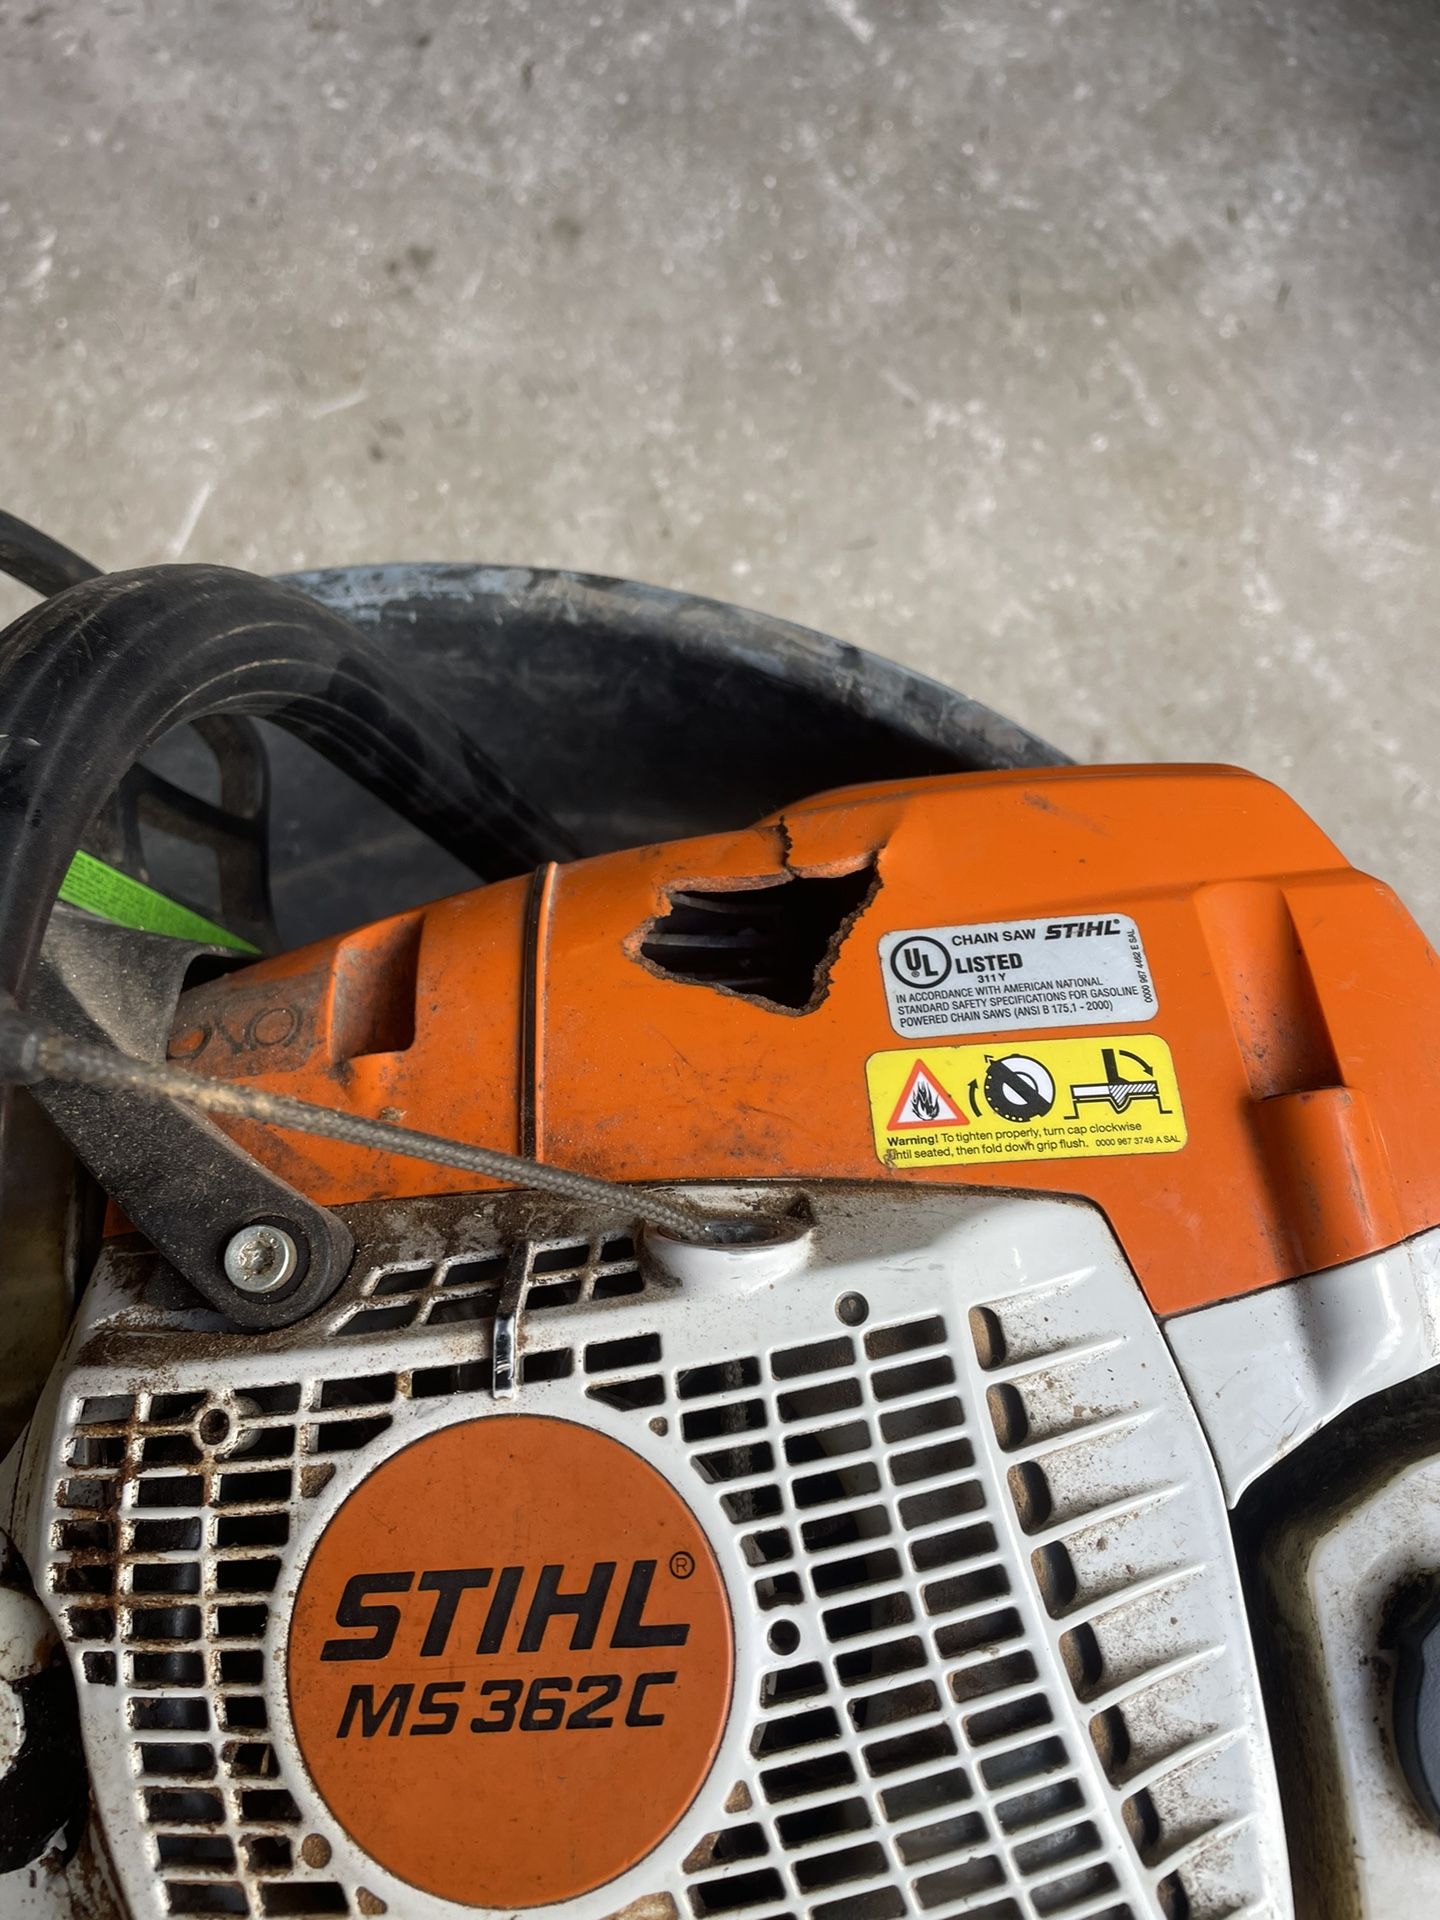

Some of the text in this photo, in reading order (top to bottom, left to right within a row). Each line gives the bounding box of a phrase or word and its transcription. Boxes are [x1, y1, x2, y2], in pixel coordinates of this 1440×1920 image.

[952, 928, 1036, 946] CHAIN SAW
[1126, 928, 1138, 944] SAL
[904, 948, 939, 977] UL
[955, 953, 1023, 974] LISTED
[896, 977, 1104, 1004] IN ACCORDANCE WITH AMERICAN NATIONAL
[898, 986, 1140, 1016] STANDARD SAFETY SPECIFICATIONS FOR GASOLINE
[900, 1014, 948, 1028] POWERED
[950, 1011, 981, 1023] CHAIN
[982, 1008, 1012, 1020] SAWS
[1014, 1004, 1040, 1019] (ANSI
[1042, 1005, 1050, 1014] B
[1086, 1000, 1114, 1012] 2000)
[887, 1122, 1142, 1147] Warning! To tighten properly, turn cap clockwise
[1096, 1134, 1181, 1148] 0000 967 3749 A SAL
[914, 1146, 954, 1159] seated,
[956, 1145, 981, 1156] then
[982, 1143, 1002, 1154] fold
[1004, 1140, 1034, 1152] down
[1036, 1140, 1058, 1152] grip
[1060, 1138, 1089, 1148] flush.
